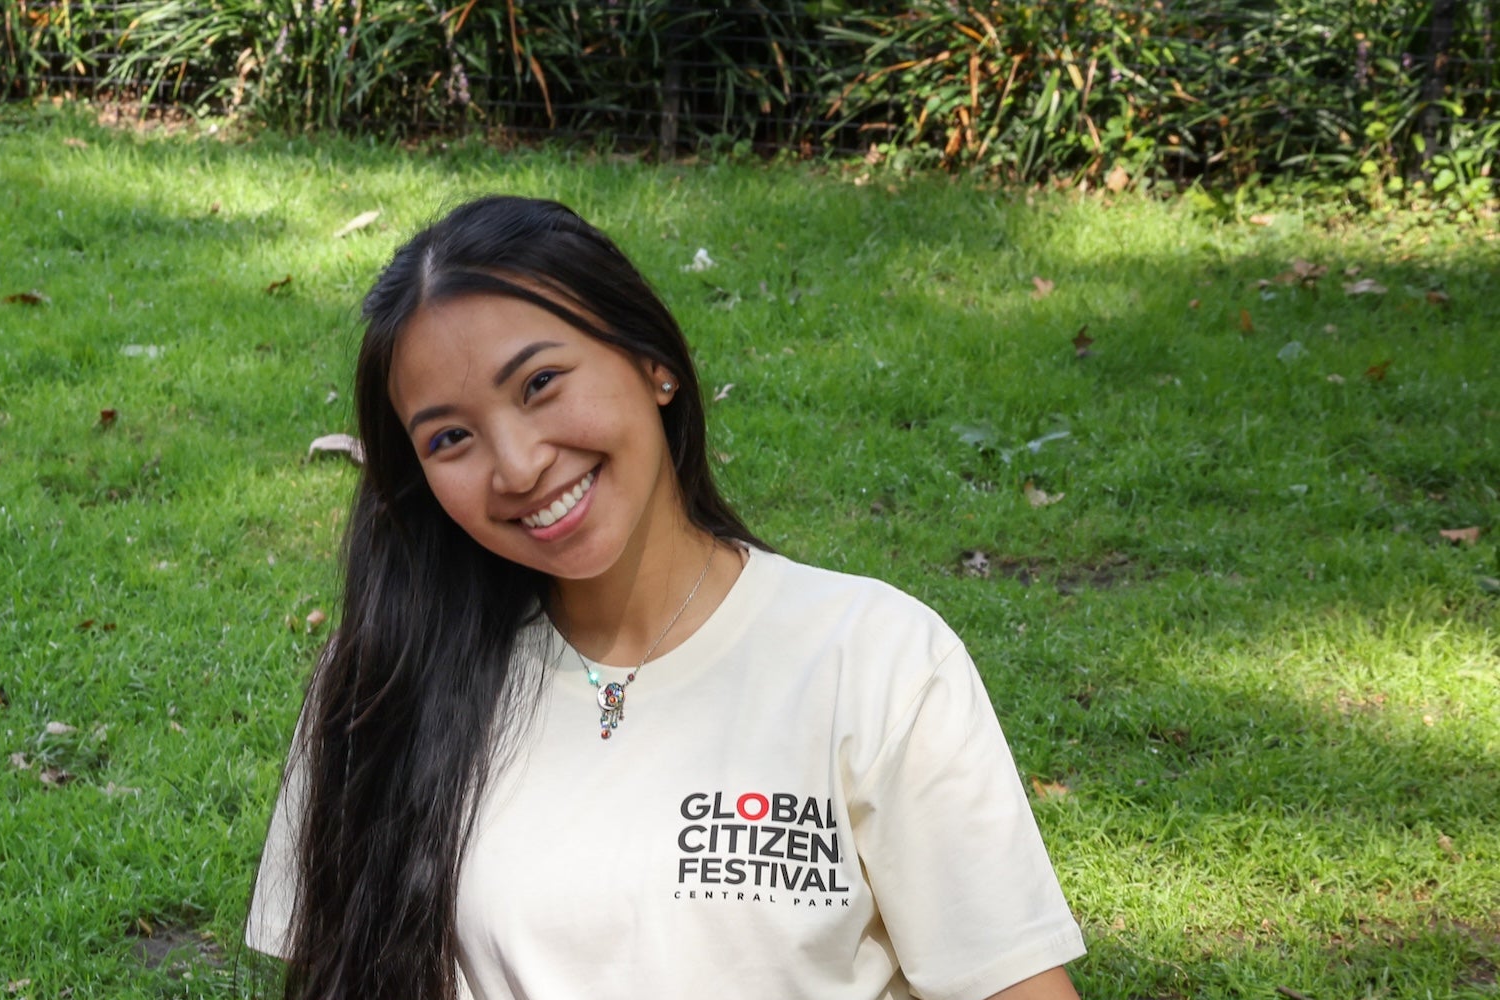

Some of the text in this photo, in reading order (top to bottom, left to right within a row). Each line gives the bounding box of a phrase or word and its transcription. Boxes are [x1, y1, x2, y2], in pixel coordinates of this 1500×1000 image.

[680, 791, 837, 829] GLOBAL
[677, 824, 840, 864] CITIZEN
[678, 857, 850, 893] FESTIVAL
[674, 890, 850, 908] CENTRAL PARK
